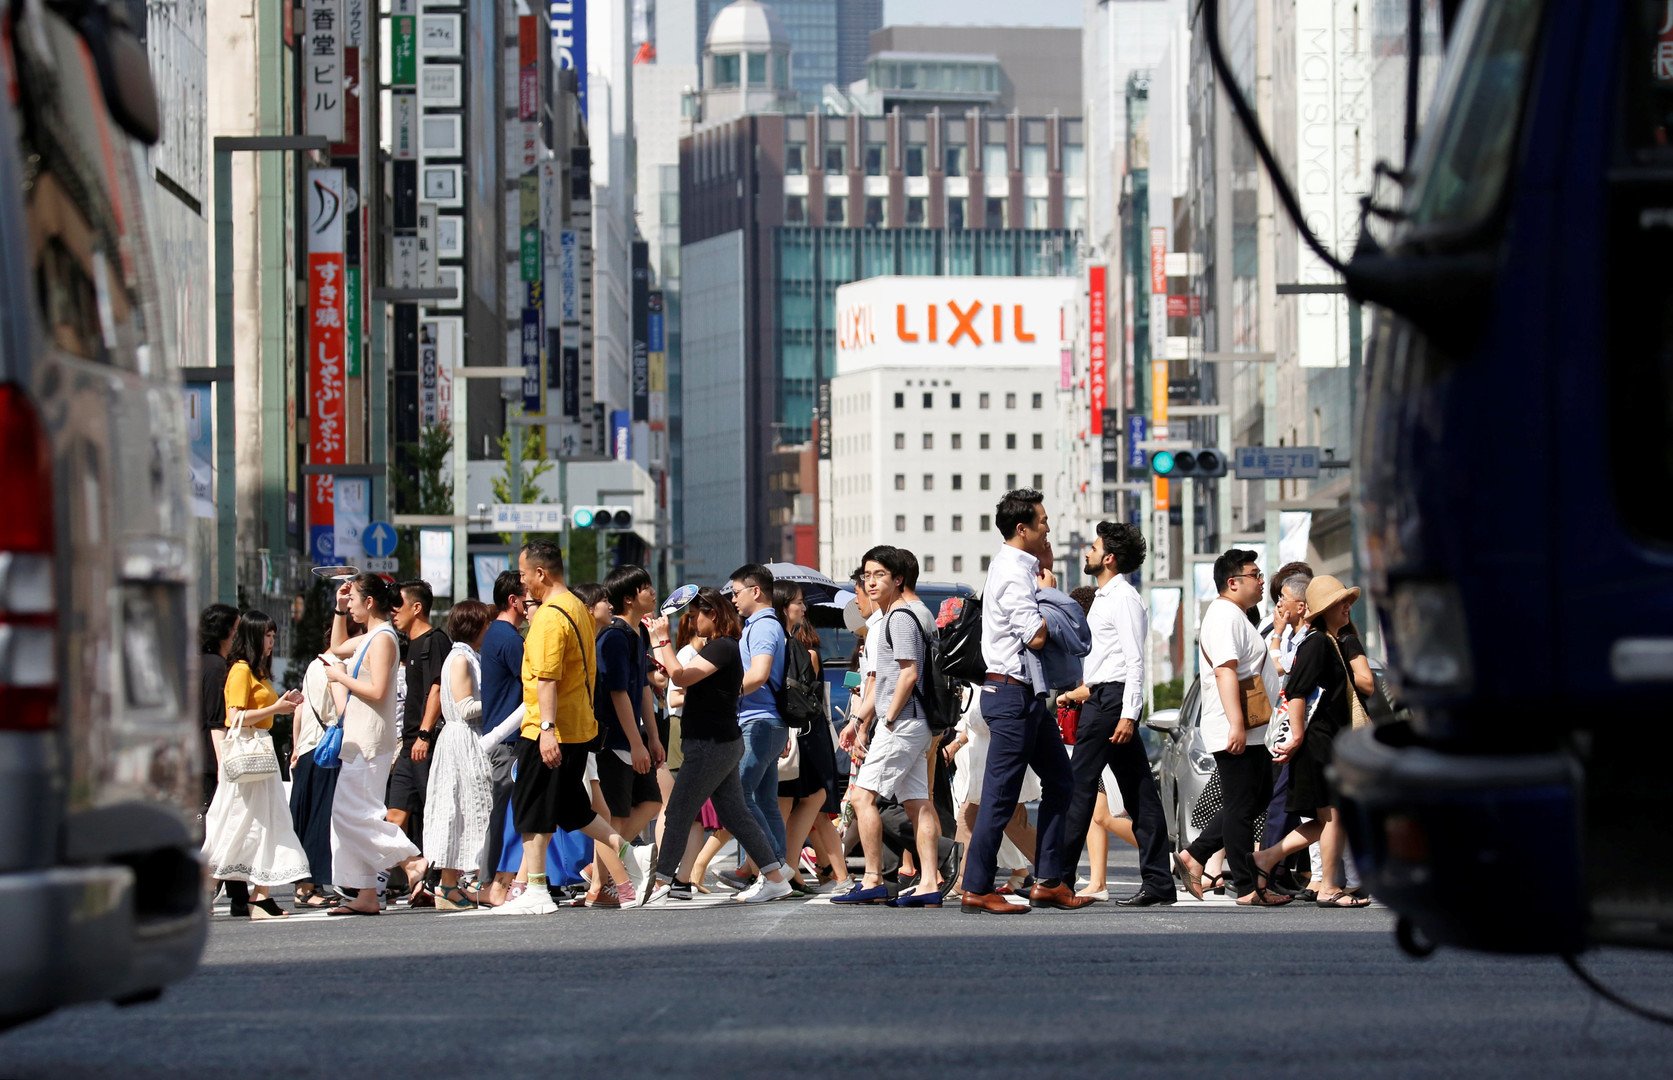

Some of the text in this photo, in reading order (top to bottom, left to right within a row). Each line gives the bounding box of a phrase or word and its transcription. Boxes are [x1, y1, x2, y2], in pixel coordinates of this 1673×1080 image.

[896, 299, 1036, 348] LIXIL
[497, 511, 558, 522] 銀座三丁目
